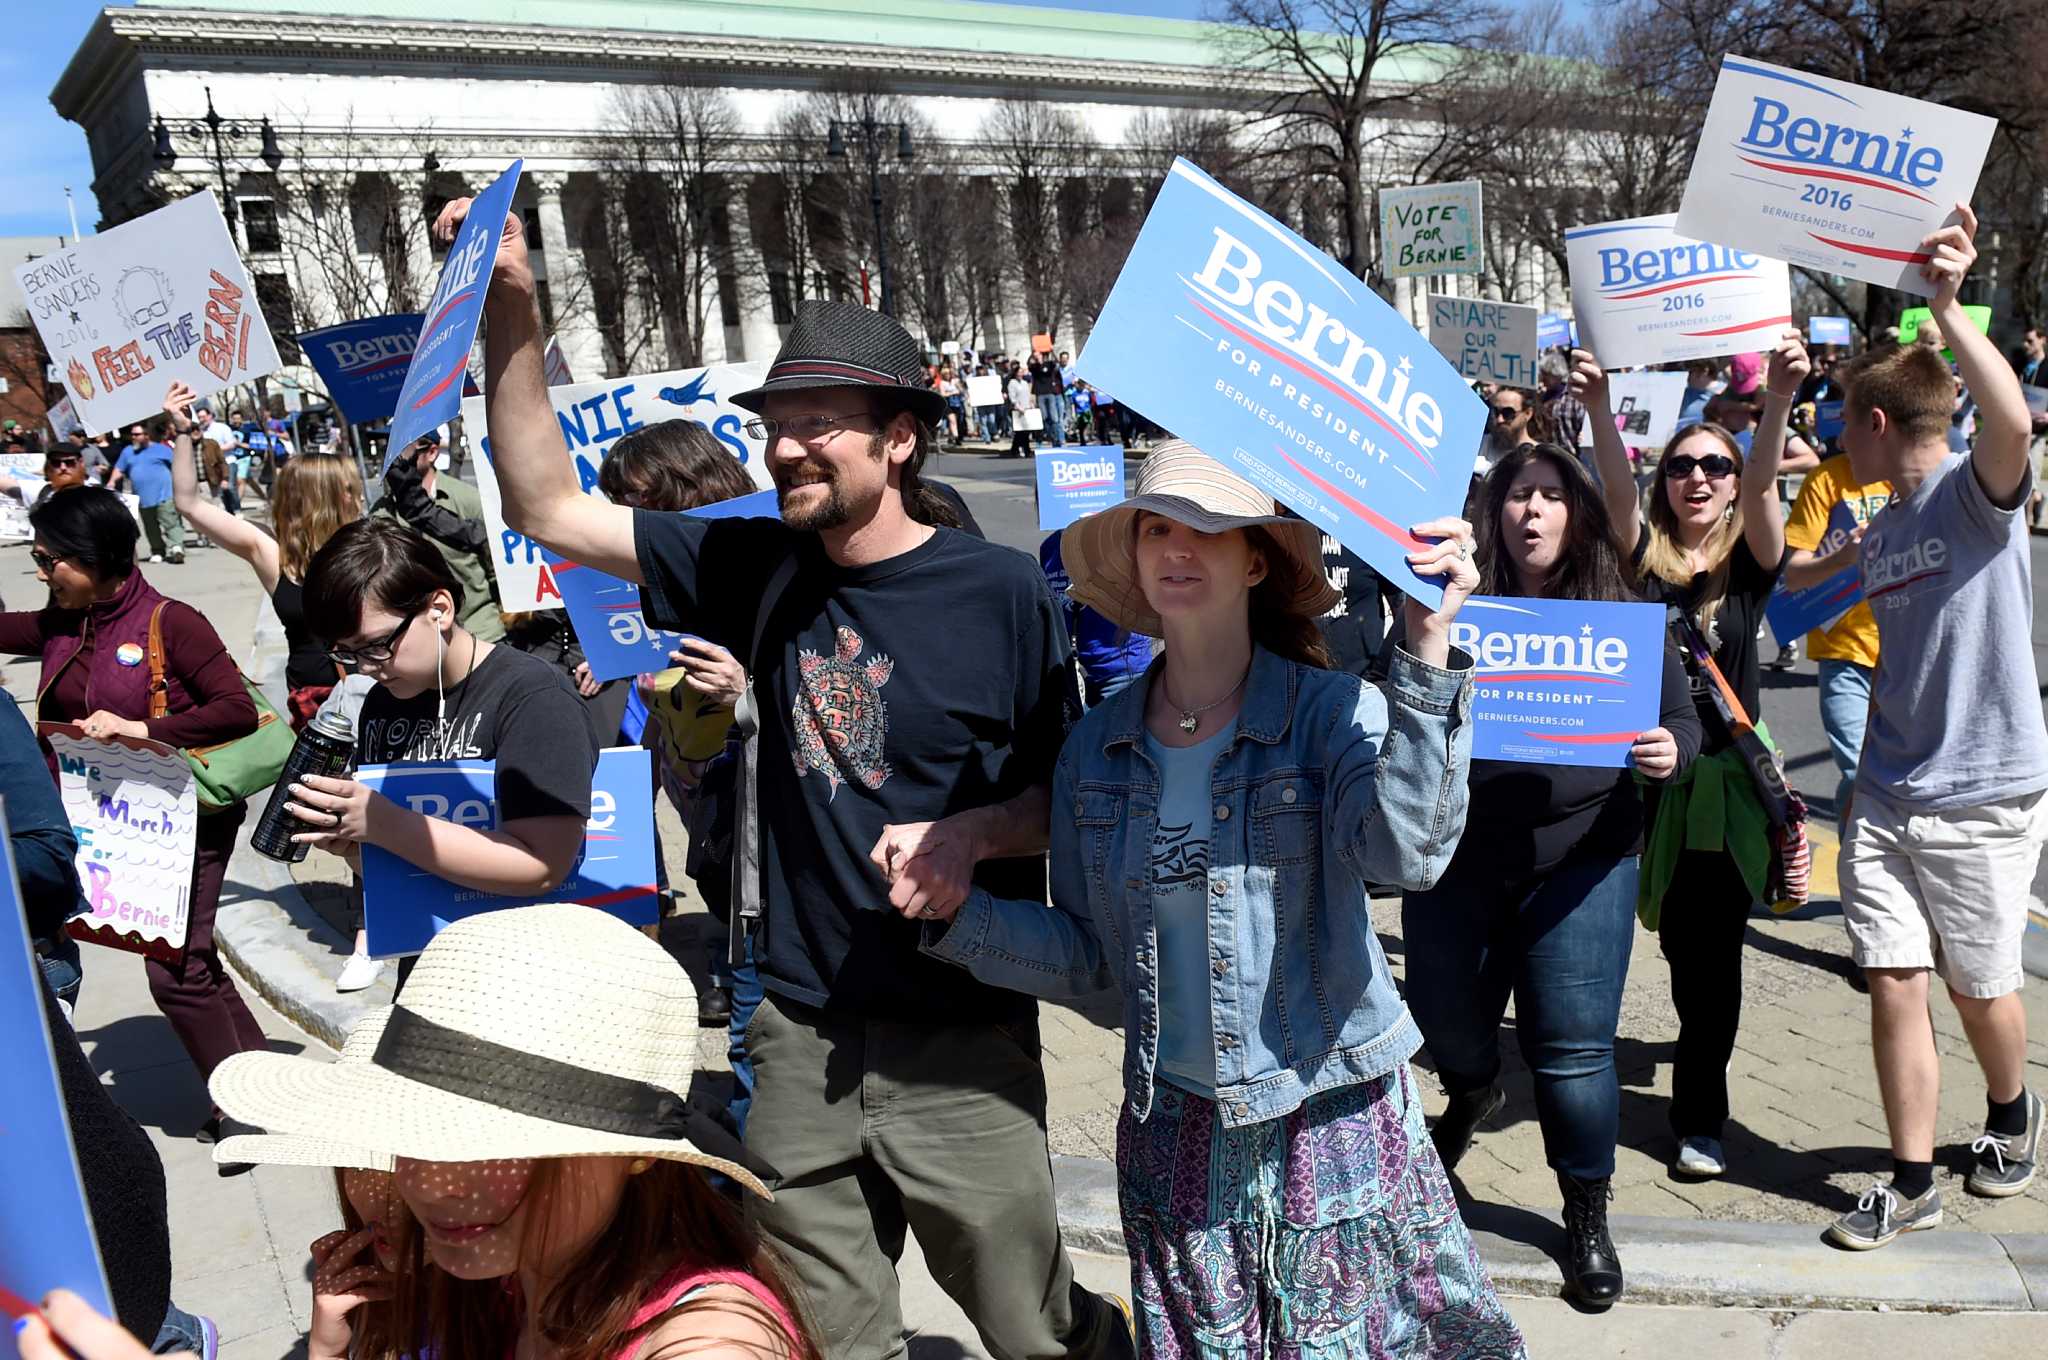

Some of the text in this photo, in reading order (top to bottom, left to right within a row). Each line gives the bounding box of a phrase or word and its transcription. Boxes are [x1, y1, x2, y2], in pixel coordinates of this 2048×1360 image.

[1741, 96, 1944, 188] Bernie
[1800, 183, 1853, 211] 2016
[1395, 202, 1459, 230] VOTE
[1762, 204, 1876, 240] BERNIESANDERS.COM
[1413, 226, 1444, 245] FOR
[1399, 244, 1467, 268] BERNIE
[1598, 240, 1760, 287] Bernie
[22, 252, 83, 295] BERNIE
[33, 272, 101, 320] SANDERS
[1662, 293, 1705, 312] 2016
[91, 267, 244, 393] FEEL THE BERN
[1435, 301, 1511, 331] SHARE
[1637, 313, 1732, 333] BERNIESANDERS.COM
[55, 322, 99, 349] 2016
[326, 327, 418, 369] Berni
[1192, 225, 1443, 449] Bernie
[1464, 332, 1497, 348] OUR
[1217, 339, 1390, 464] FOR PRESIDENT
[1215, 378, 1368, 489] BERNIESANDERS.COM
[1051, 457, 1117, 484] Bernie
[1450, 622, 1629, 674] Bernie
[1474, 688, 1594, 705] FOR PRESIDENT
[1478, 712, 1584, 727] BERNIESANDERS.COM
[59, 752, 101, 782] We
[99, 794, 174, 836] March
[73, 825, 113, 860] For
